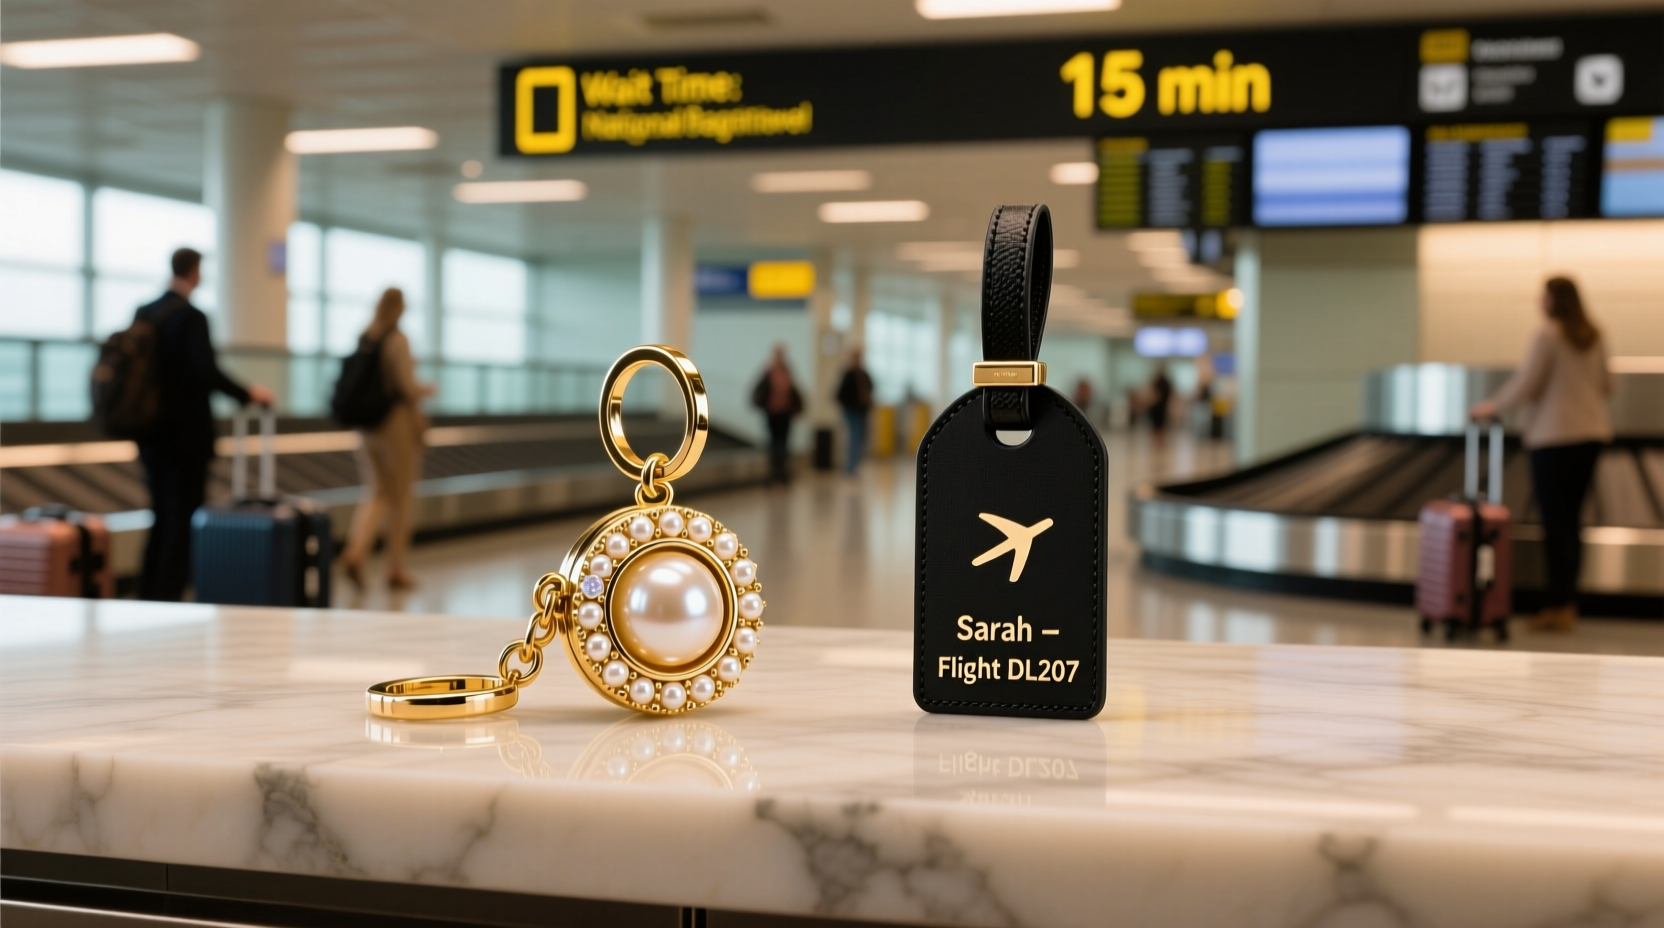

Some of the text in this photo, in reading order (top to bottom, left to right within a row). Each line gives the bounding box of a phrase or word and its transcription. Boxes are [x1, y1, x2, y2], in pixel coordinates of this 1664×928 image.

[580, 68, 653, 107] Wait
[1061, 50, 1272, 118] 15 min
[957, 615, 1033, 643] Sarah
[939, 656, 1080, 685] Flight DL207
